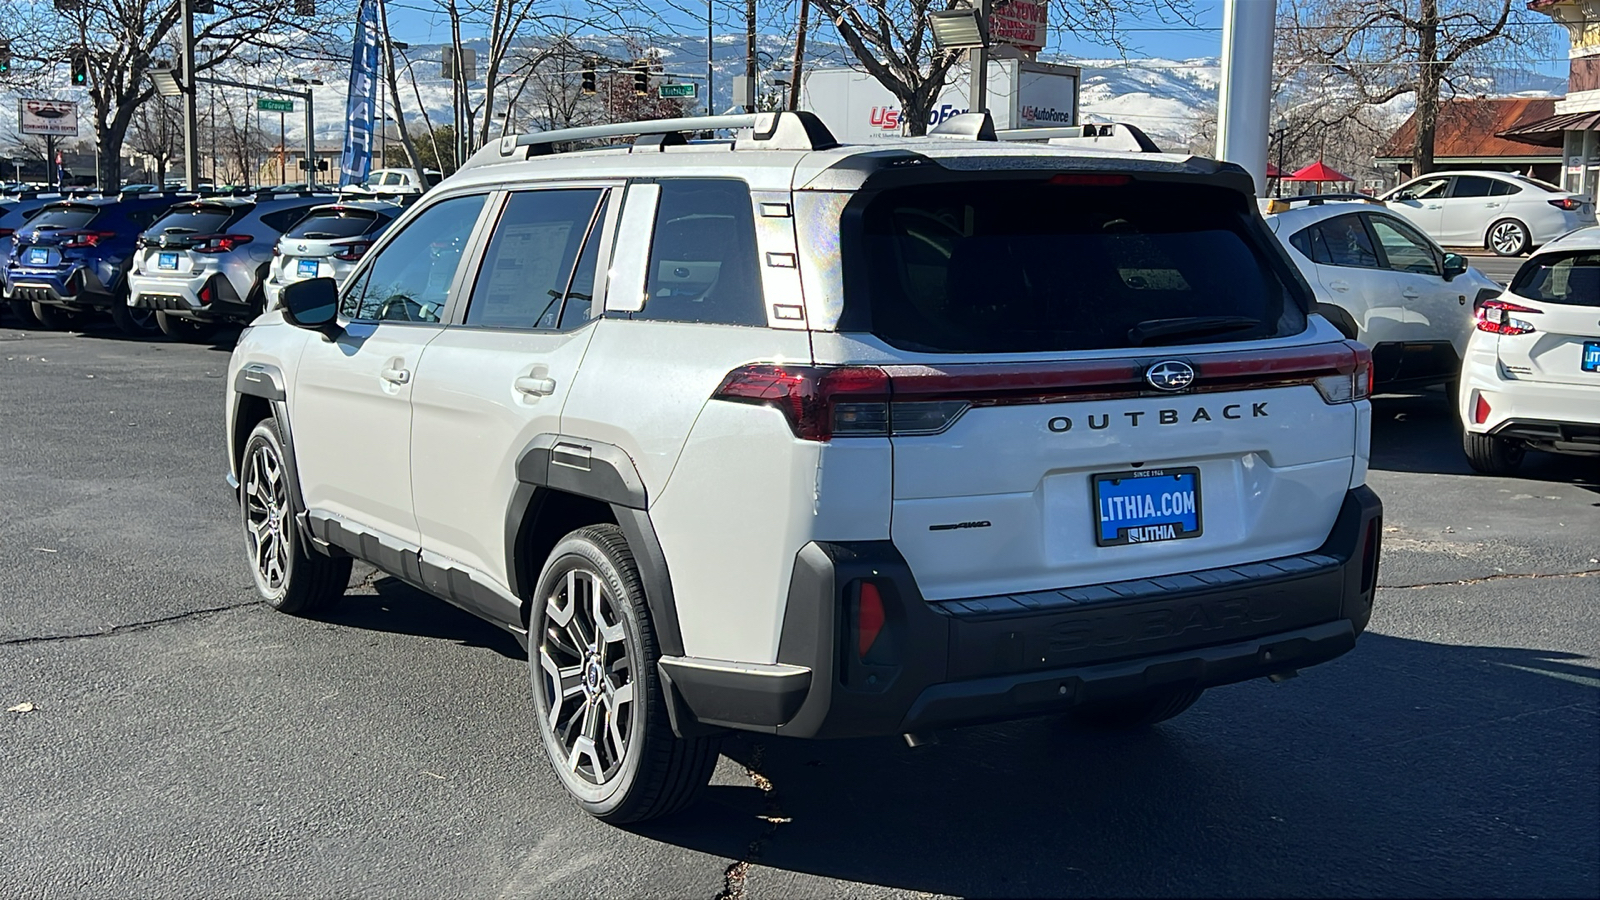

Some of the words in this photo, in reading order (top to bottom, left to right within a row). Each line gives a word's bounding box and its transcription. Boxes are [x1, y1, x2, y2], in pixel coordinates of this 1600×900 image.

[1048, 403, 1268, 432] OUTBACK
[1100, 491, 1195, 521] LITHIA.COM
[1140, 525, 1176, 541] LITHIA
[1050, 590, 1285, 651] SUBARU
